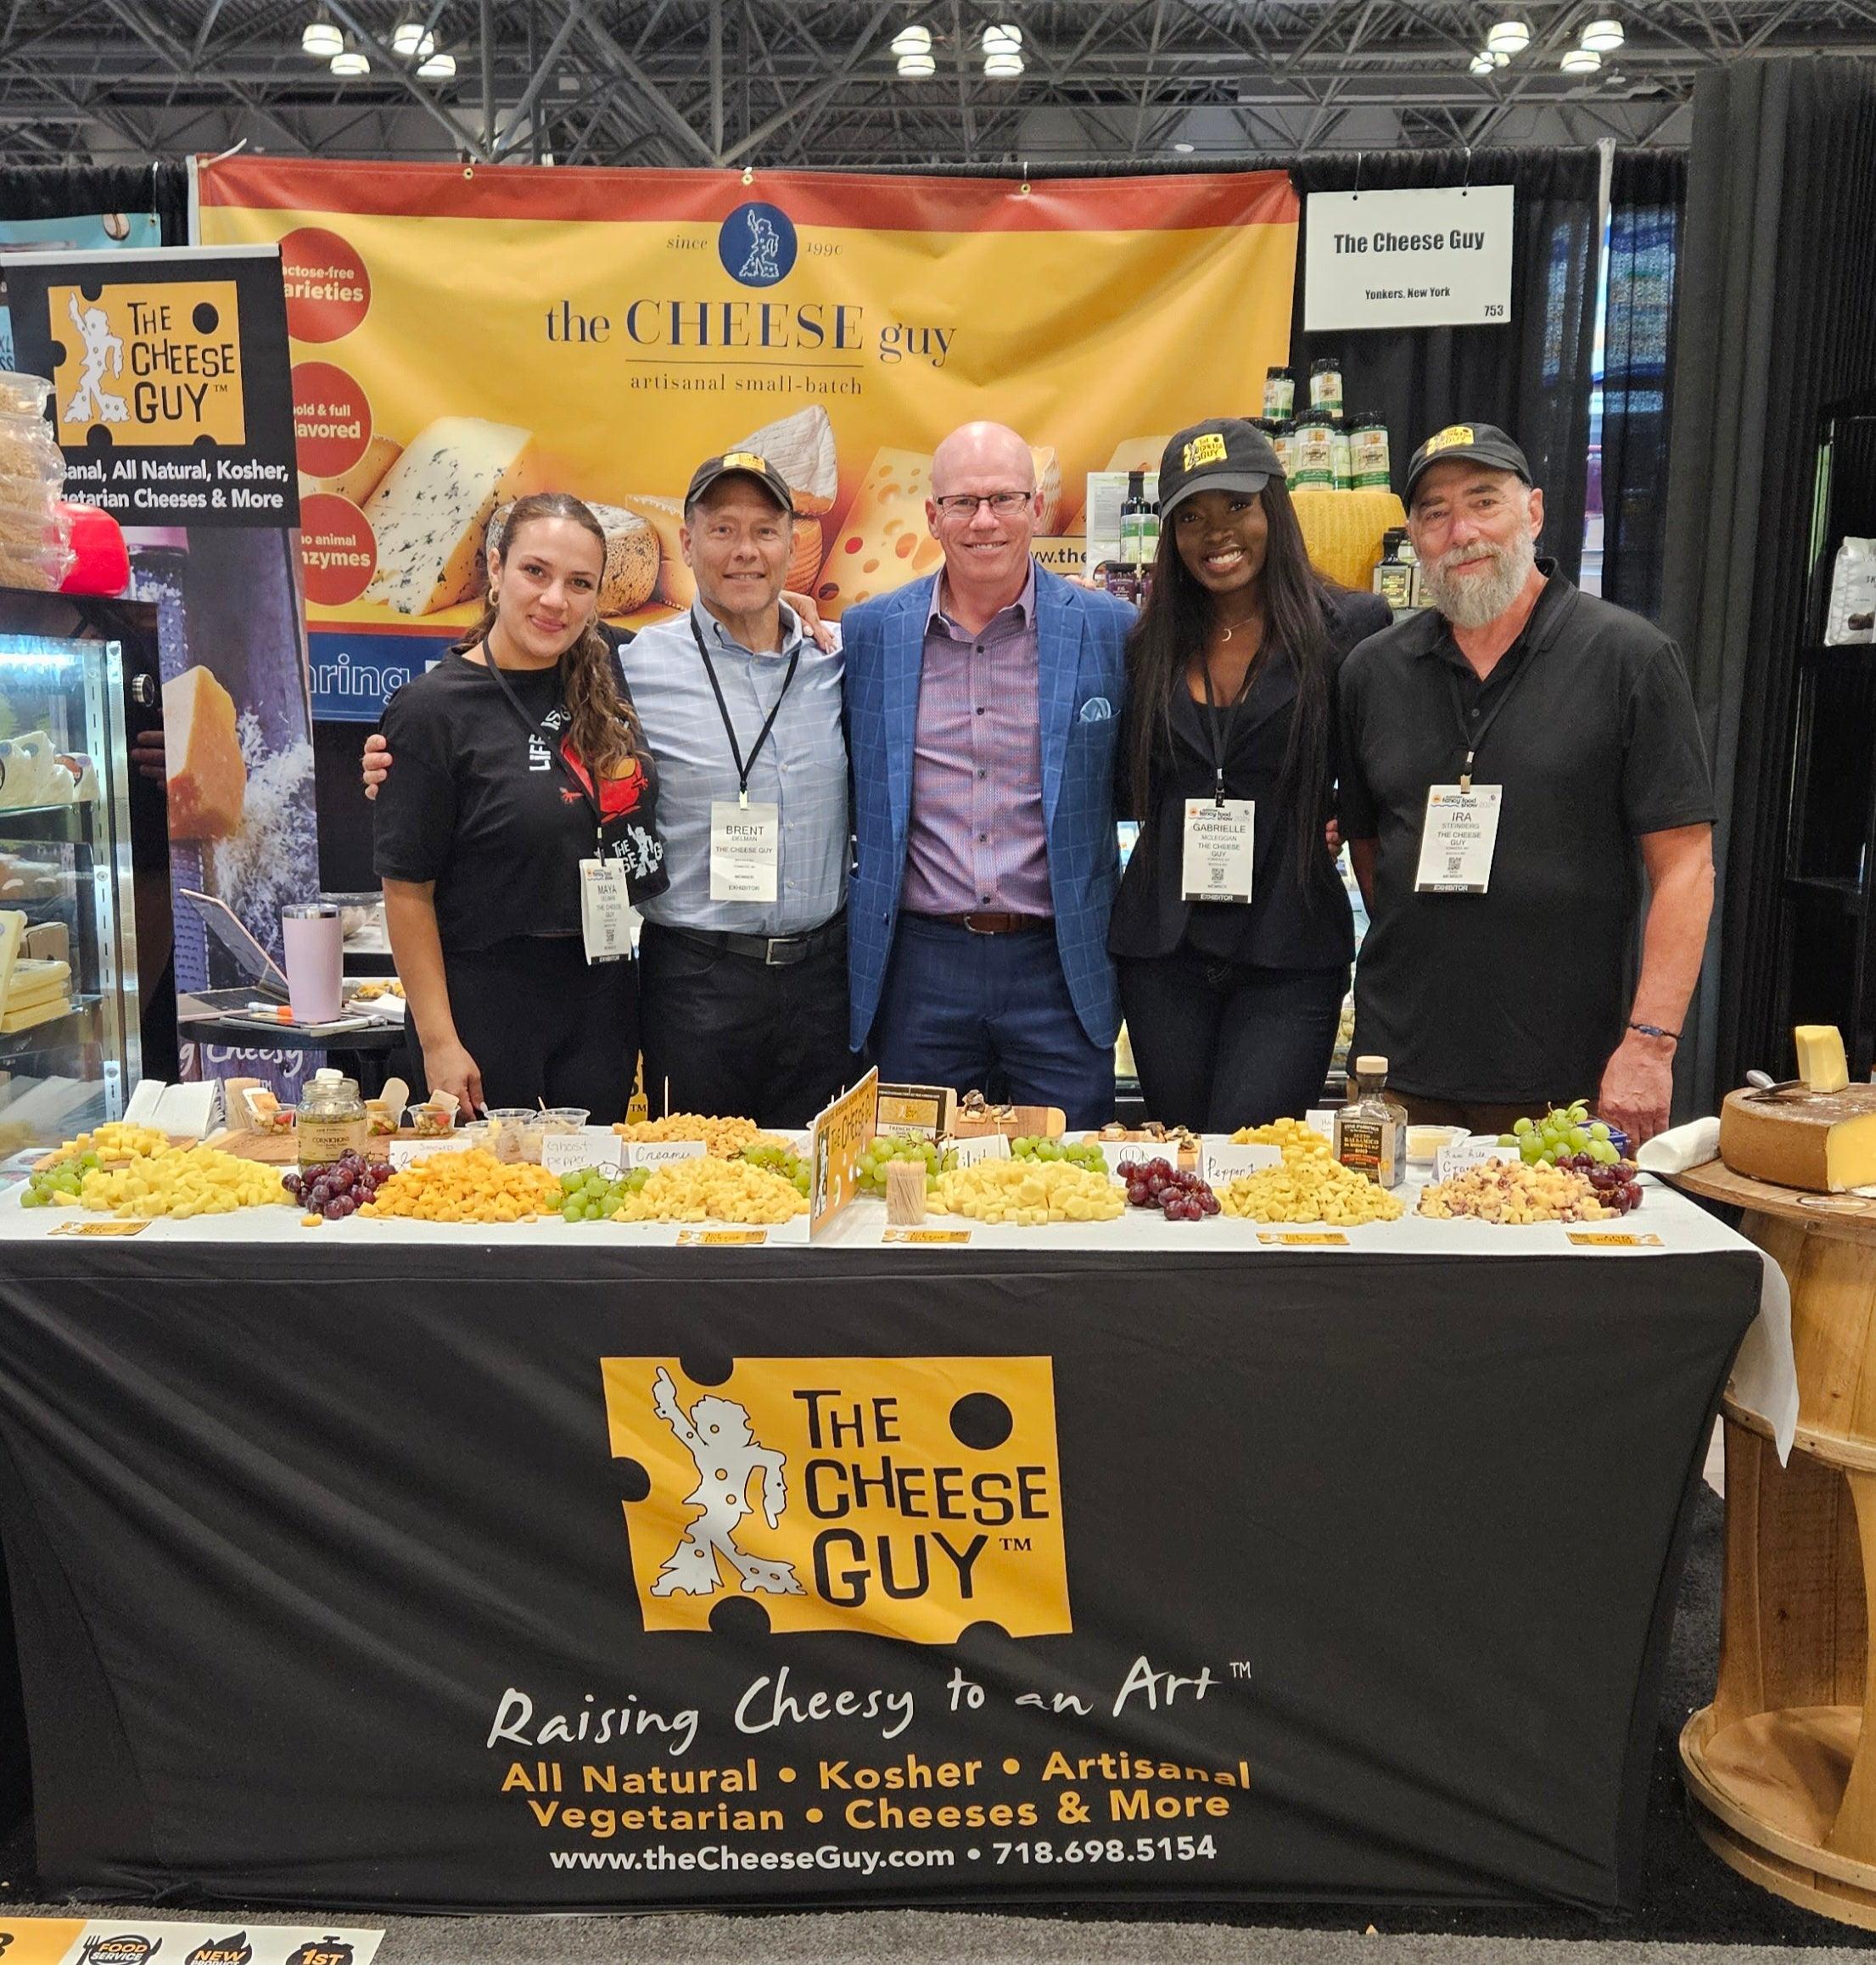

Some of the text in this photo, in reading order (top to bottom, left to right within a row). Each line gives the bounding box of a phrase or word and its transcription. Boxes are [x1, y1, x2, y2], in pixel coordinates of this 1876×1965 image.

[666, 234, 708, 249] since
[1334, 229, 1485, 254] The Cheese Guy
[283, 265, 355, 279] actose-free
[284, 280, 364, 302] arieties
[1365, 286, 1451, 300] Yonkers, New York
[127, 302, 171, 335] THE
[1484, 305, 1504, 317] 753
[546, 299, 957, 367] the CHEESE guy
[132, 339, 235, 378] CHEESE
[630, 373, 862, 395] artisanal small-batch
[134, 382, 228, 424] GUY TM
[317, 404, 327, 417] &
[328, 405, 350, 417] full
[294, 421, 361, 439] lavored
[61, 459, 289, 484] sanal, All Natural, Kosher,
[59, 489, 283, 508] getarian Cheeses & More
[315, 533, 356, 546] animal
[302, 551, 371, 570] nzymes
[529, 734, 551, 771] LIFE
[1452, 812, 1472, 822] IRA
[726, 826, 764, 836] BRENT
[1192, 823, 1246, 833] GABRIELLE
[612, 839, 630, 858] THE
[597, 884, 617, 895] MAYA
[630, 1104, 647, 1112] TM
[546, 1140, 588, 1152] Ghost
[792, 1389, 901, 1449] THE
[804, 1455, 1050, 1526] CHEESE
[812, 1527, 1033, 1609] GUY TM
[487, 1655, 1252, 1755] Raising Cheesy to an Art TM
[501, 1750, 1252, 1795] All Natural Kosher Artisanal
[528, 1788, 1231, 1840] Vegetarian Cheeses & More
[549, 1834, 1218, 1875] www.theCheeseGuy.com 718.698.5154
[90, 1951, 144, 1962] SERVICE
[98, 1943, 149, 1953] FOOD
[193, 1950, 247, 1962] NEW
[302, 1948, 345, 1965] 1ST
